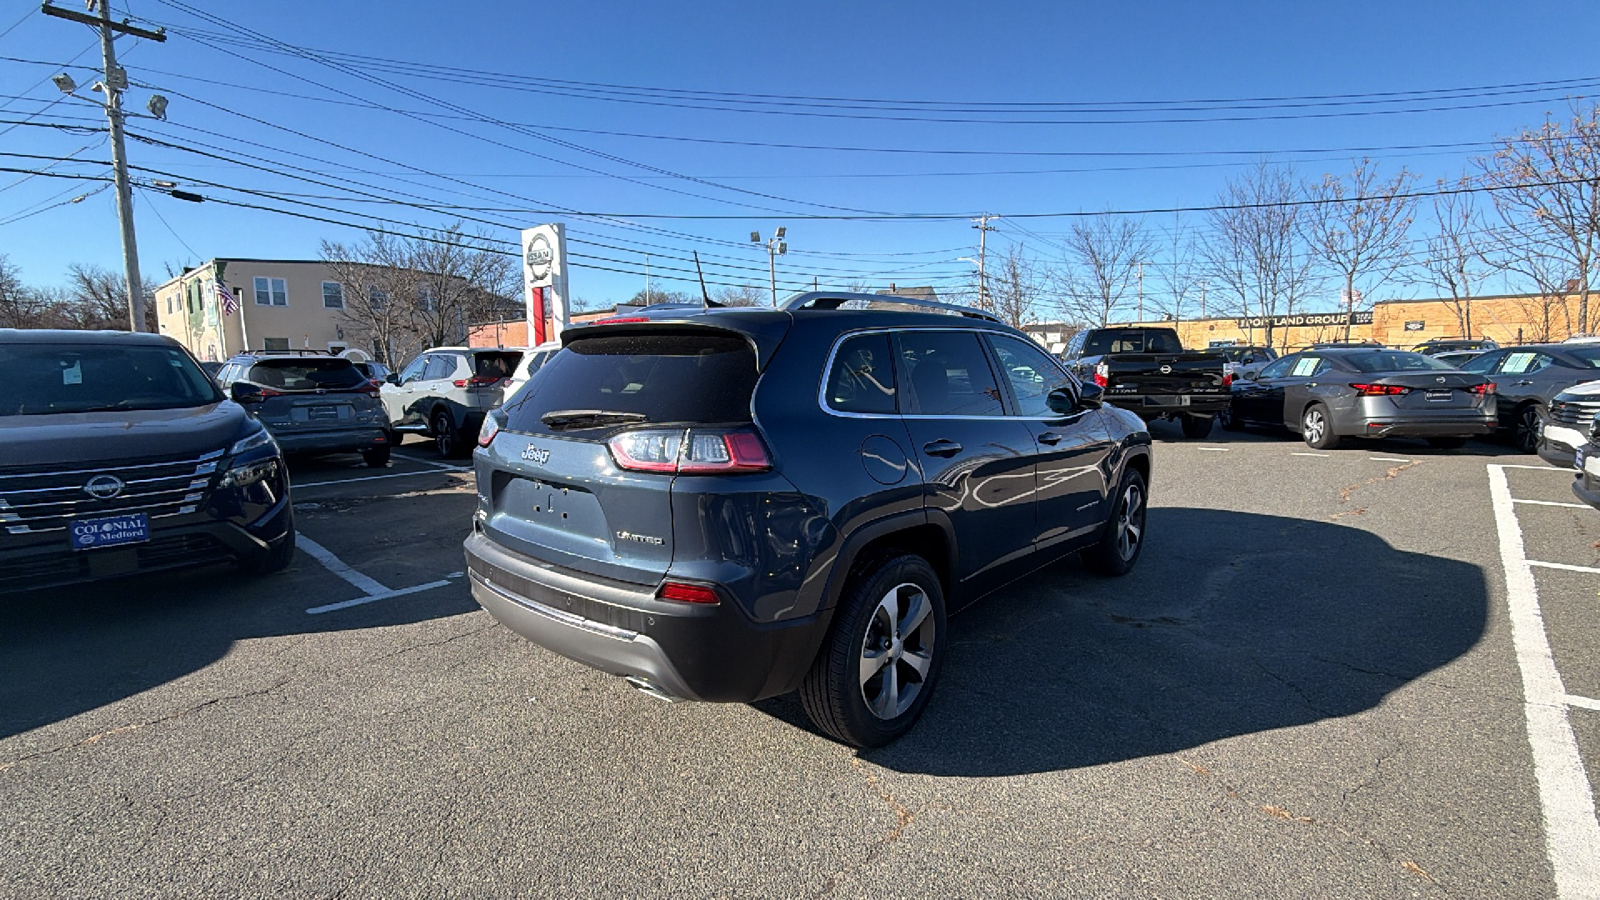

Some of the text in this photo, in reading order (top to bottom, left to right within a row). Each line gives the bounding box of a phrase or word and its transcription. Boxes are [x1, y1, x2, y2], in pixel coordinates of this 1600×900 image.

[1246, 316, 1304, 327] PORLAND
[1305, 314, 1348, 325] GROUP
[521, 443, 550, 467] Jeep
[74, 519, 146, 535] COLONIAL
[100, 528, 144, 541] Medford
